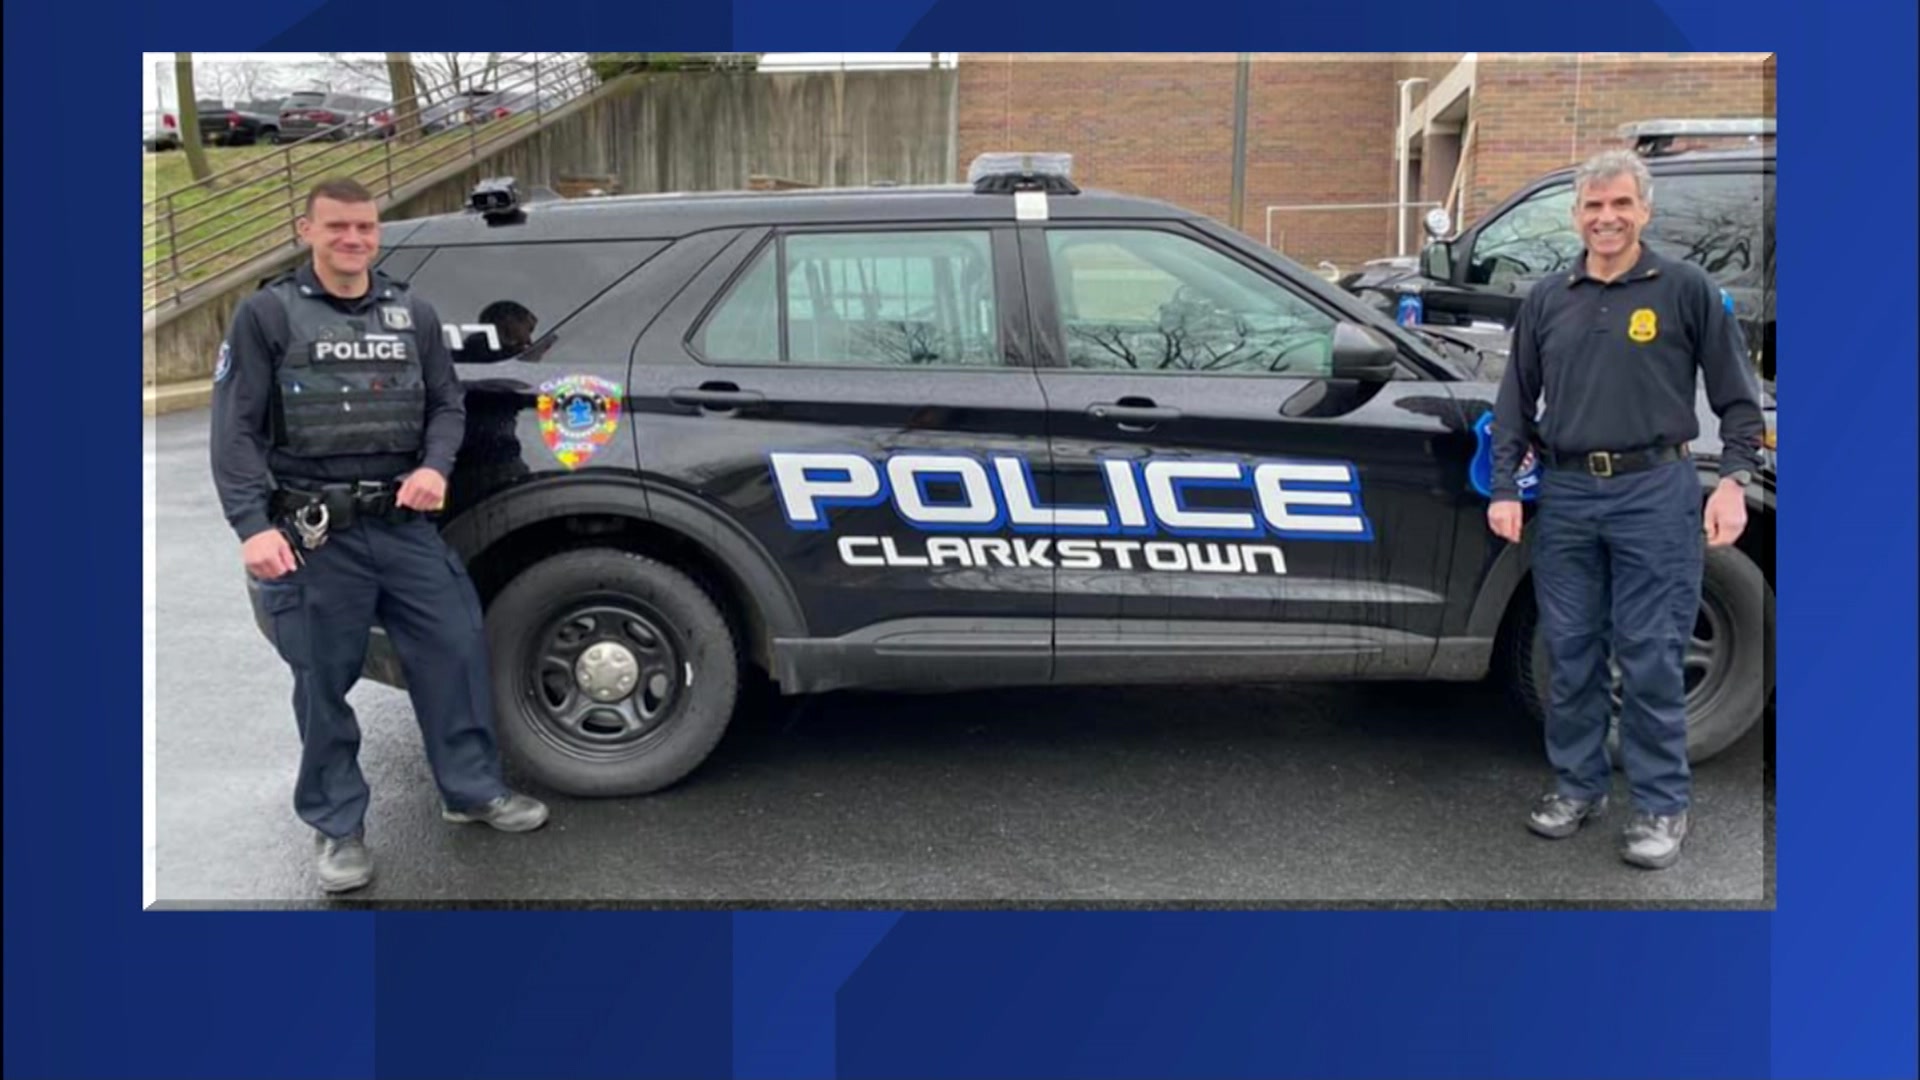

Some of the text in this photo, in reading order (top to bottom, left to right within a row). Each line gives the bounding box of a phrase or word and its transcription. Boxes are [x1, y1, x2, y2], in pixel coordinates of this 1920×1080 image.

[315, 341, 407, 360] POLICE
[769, 452, 1371, 539] POLICE
[837, 536, 1288, 574] CLARKSTOWN
